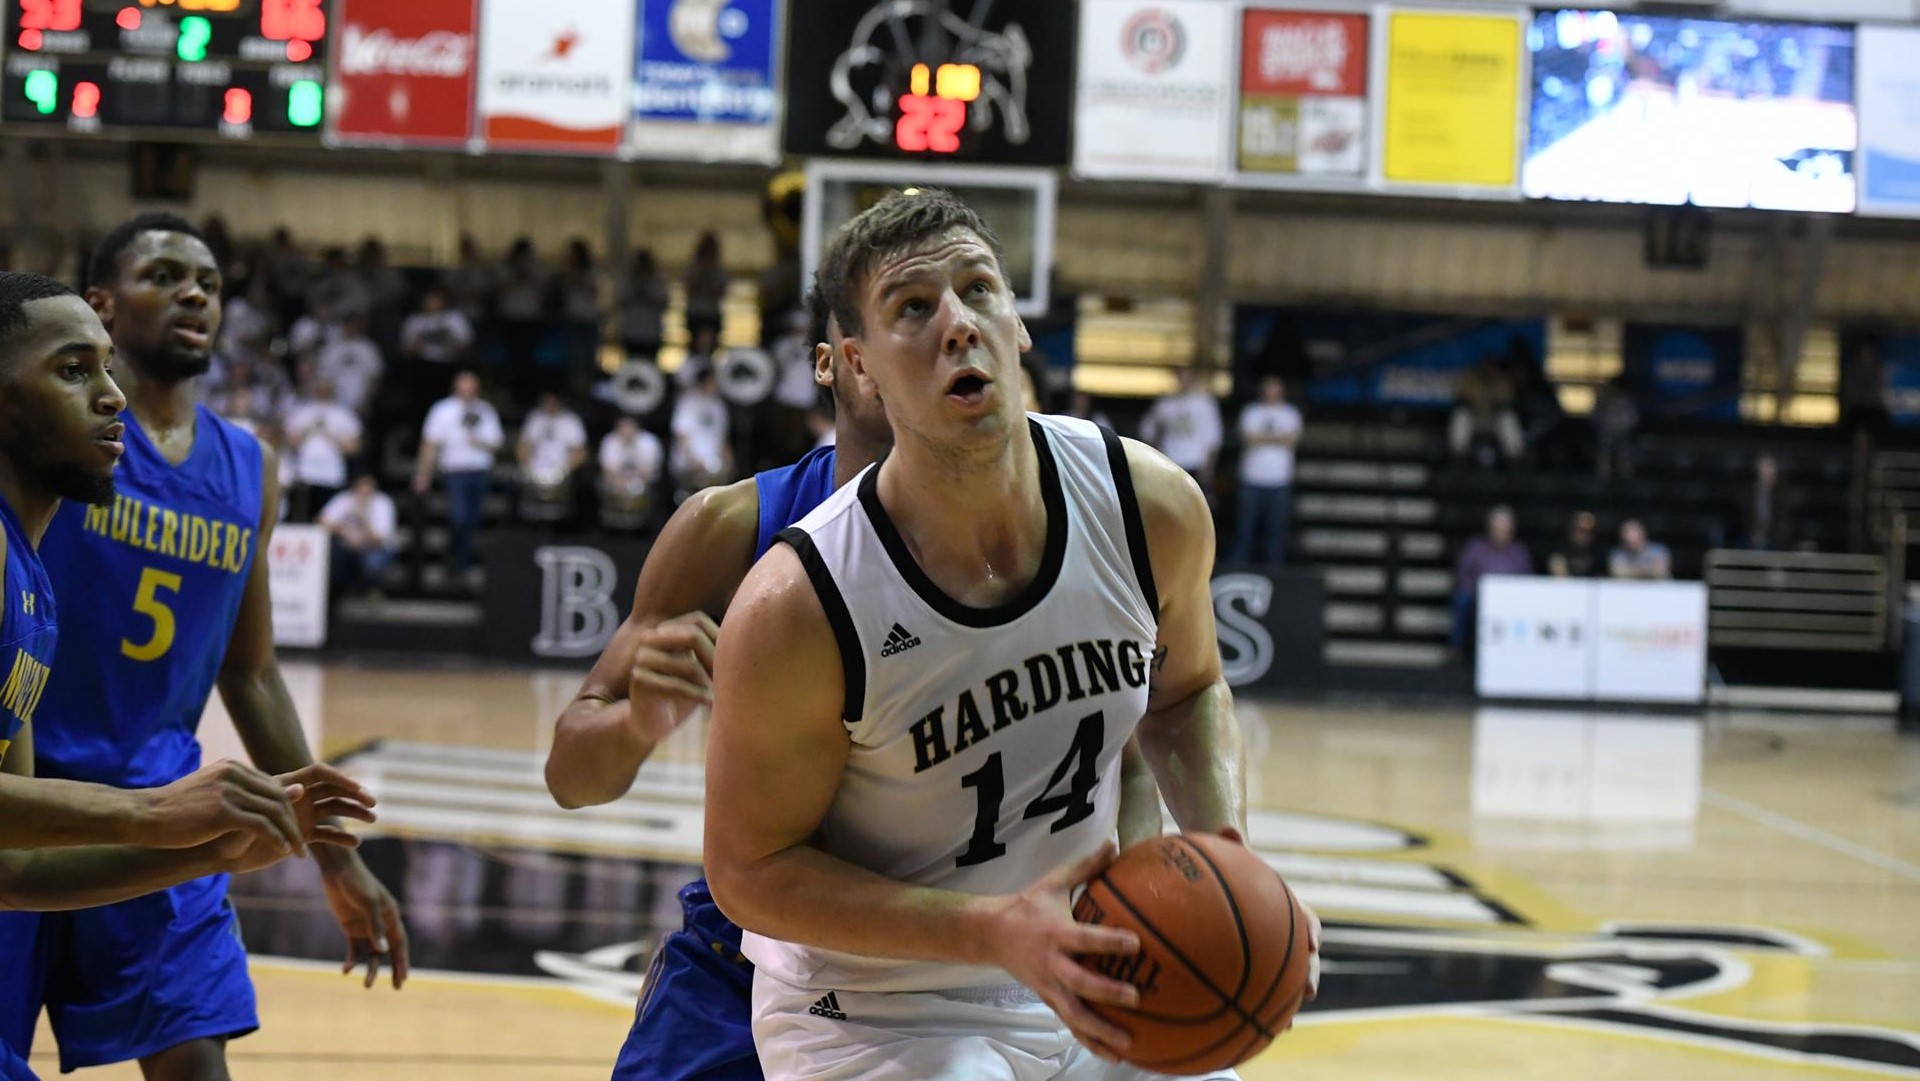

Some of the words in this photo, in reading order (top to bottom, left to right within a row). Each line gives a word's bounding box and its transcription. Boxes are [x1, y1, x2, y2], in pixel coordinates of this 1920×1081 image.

[83, 494, 252, 575] MULERIDERS
[120, 566, 183, 662] 5
[881, 636, 921, 657] adidas
[908, 638, 1147, 774] HARDING
[955, 709, 1105, 868] 14
